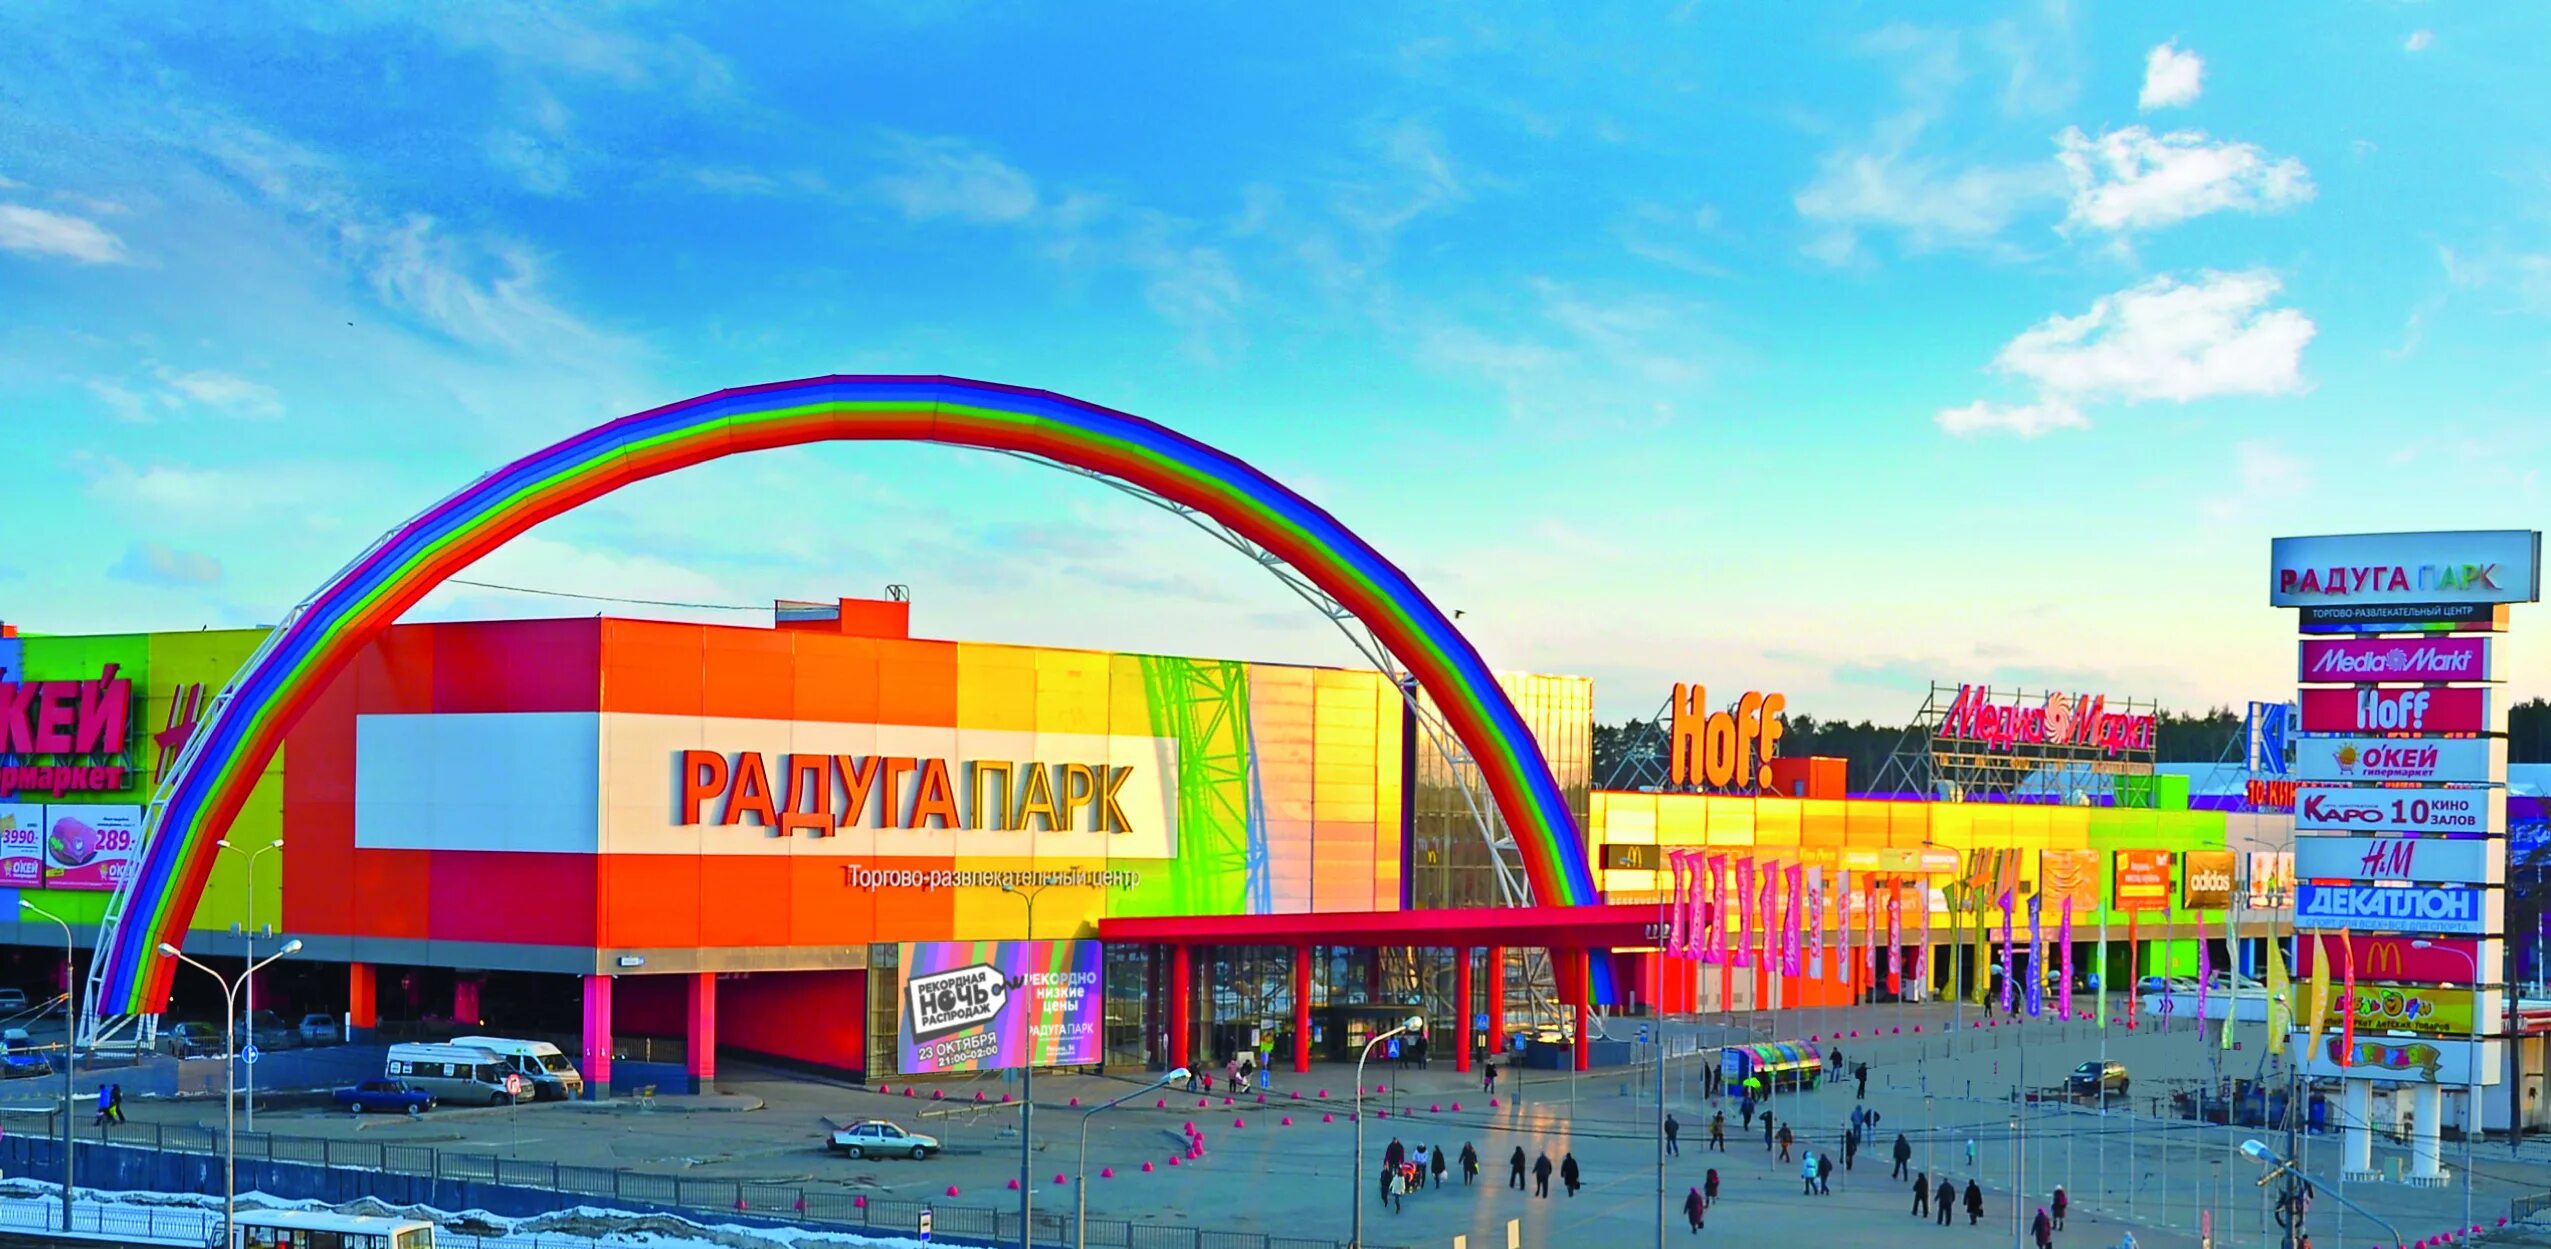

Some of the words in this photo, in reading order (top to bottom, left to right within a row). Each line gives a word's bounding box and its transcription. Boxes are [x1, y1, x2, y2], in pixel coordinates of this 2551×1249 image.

[2280, 566, 2410, 595] РАДУГА
[2418, 563, 2499, 591] ПАРК
[2313, 607, 2441, 619] ТОРГОВО-РАЗВЛЕКАТЕЛЬНЫЙ
[2443, 606, 2473, 617] ЦЕНТР
[2312, 648, 2386, 672] Media
[2403, 648, 2472, 671] Markt
[1938, 684, 2047, 750] Медиа
[2063, 693, 2156, 756] Маркт
[2363, 744, 2438, 768] О'КЕЙ
[2363, 768, 2433, 778] гипермаркет
[681, 749, 961, 837] РАДУГА
[970, 760, 1134, 834] ПАРК
[2304, 794, 2383, 823] КАРО
[2392, 800, 2429, 824] 10
[2431, 800, 2469, 811] КИНО
[2431, 813, 2476, 826] ЗАЛОВ
[2361, 840, 2415, 878] H&M
[1090, 869, 1141, 891] центр
[2191, 870, 2230, 891] adidas
[2307, 887, 2469, 918] ДЕКАТЛОН
[918, 971, 986, 995] РЕКОРДНАЯ
[1024, 971, 1097, 986] РЕКОРДНО
[919, 984, 989, 1016] НОЧЬ
[1036, 986, 1085, 999] низкие
[922, 1004, 991, 1027] РАСПРОДАЖ
[1043, 1000, 1079, 1014] цены
[1067, 1023, 1094, 1035] ПАРК
[919, 1047, 933, 1061] 23
[936, 1031, 997, 1056] ОКТЯБРЯ
